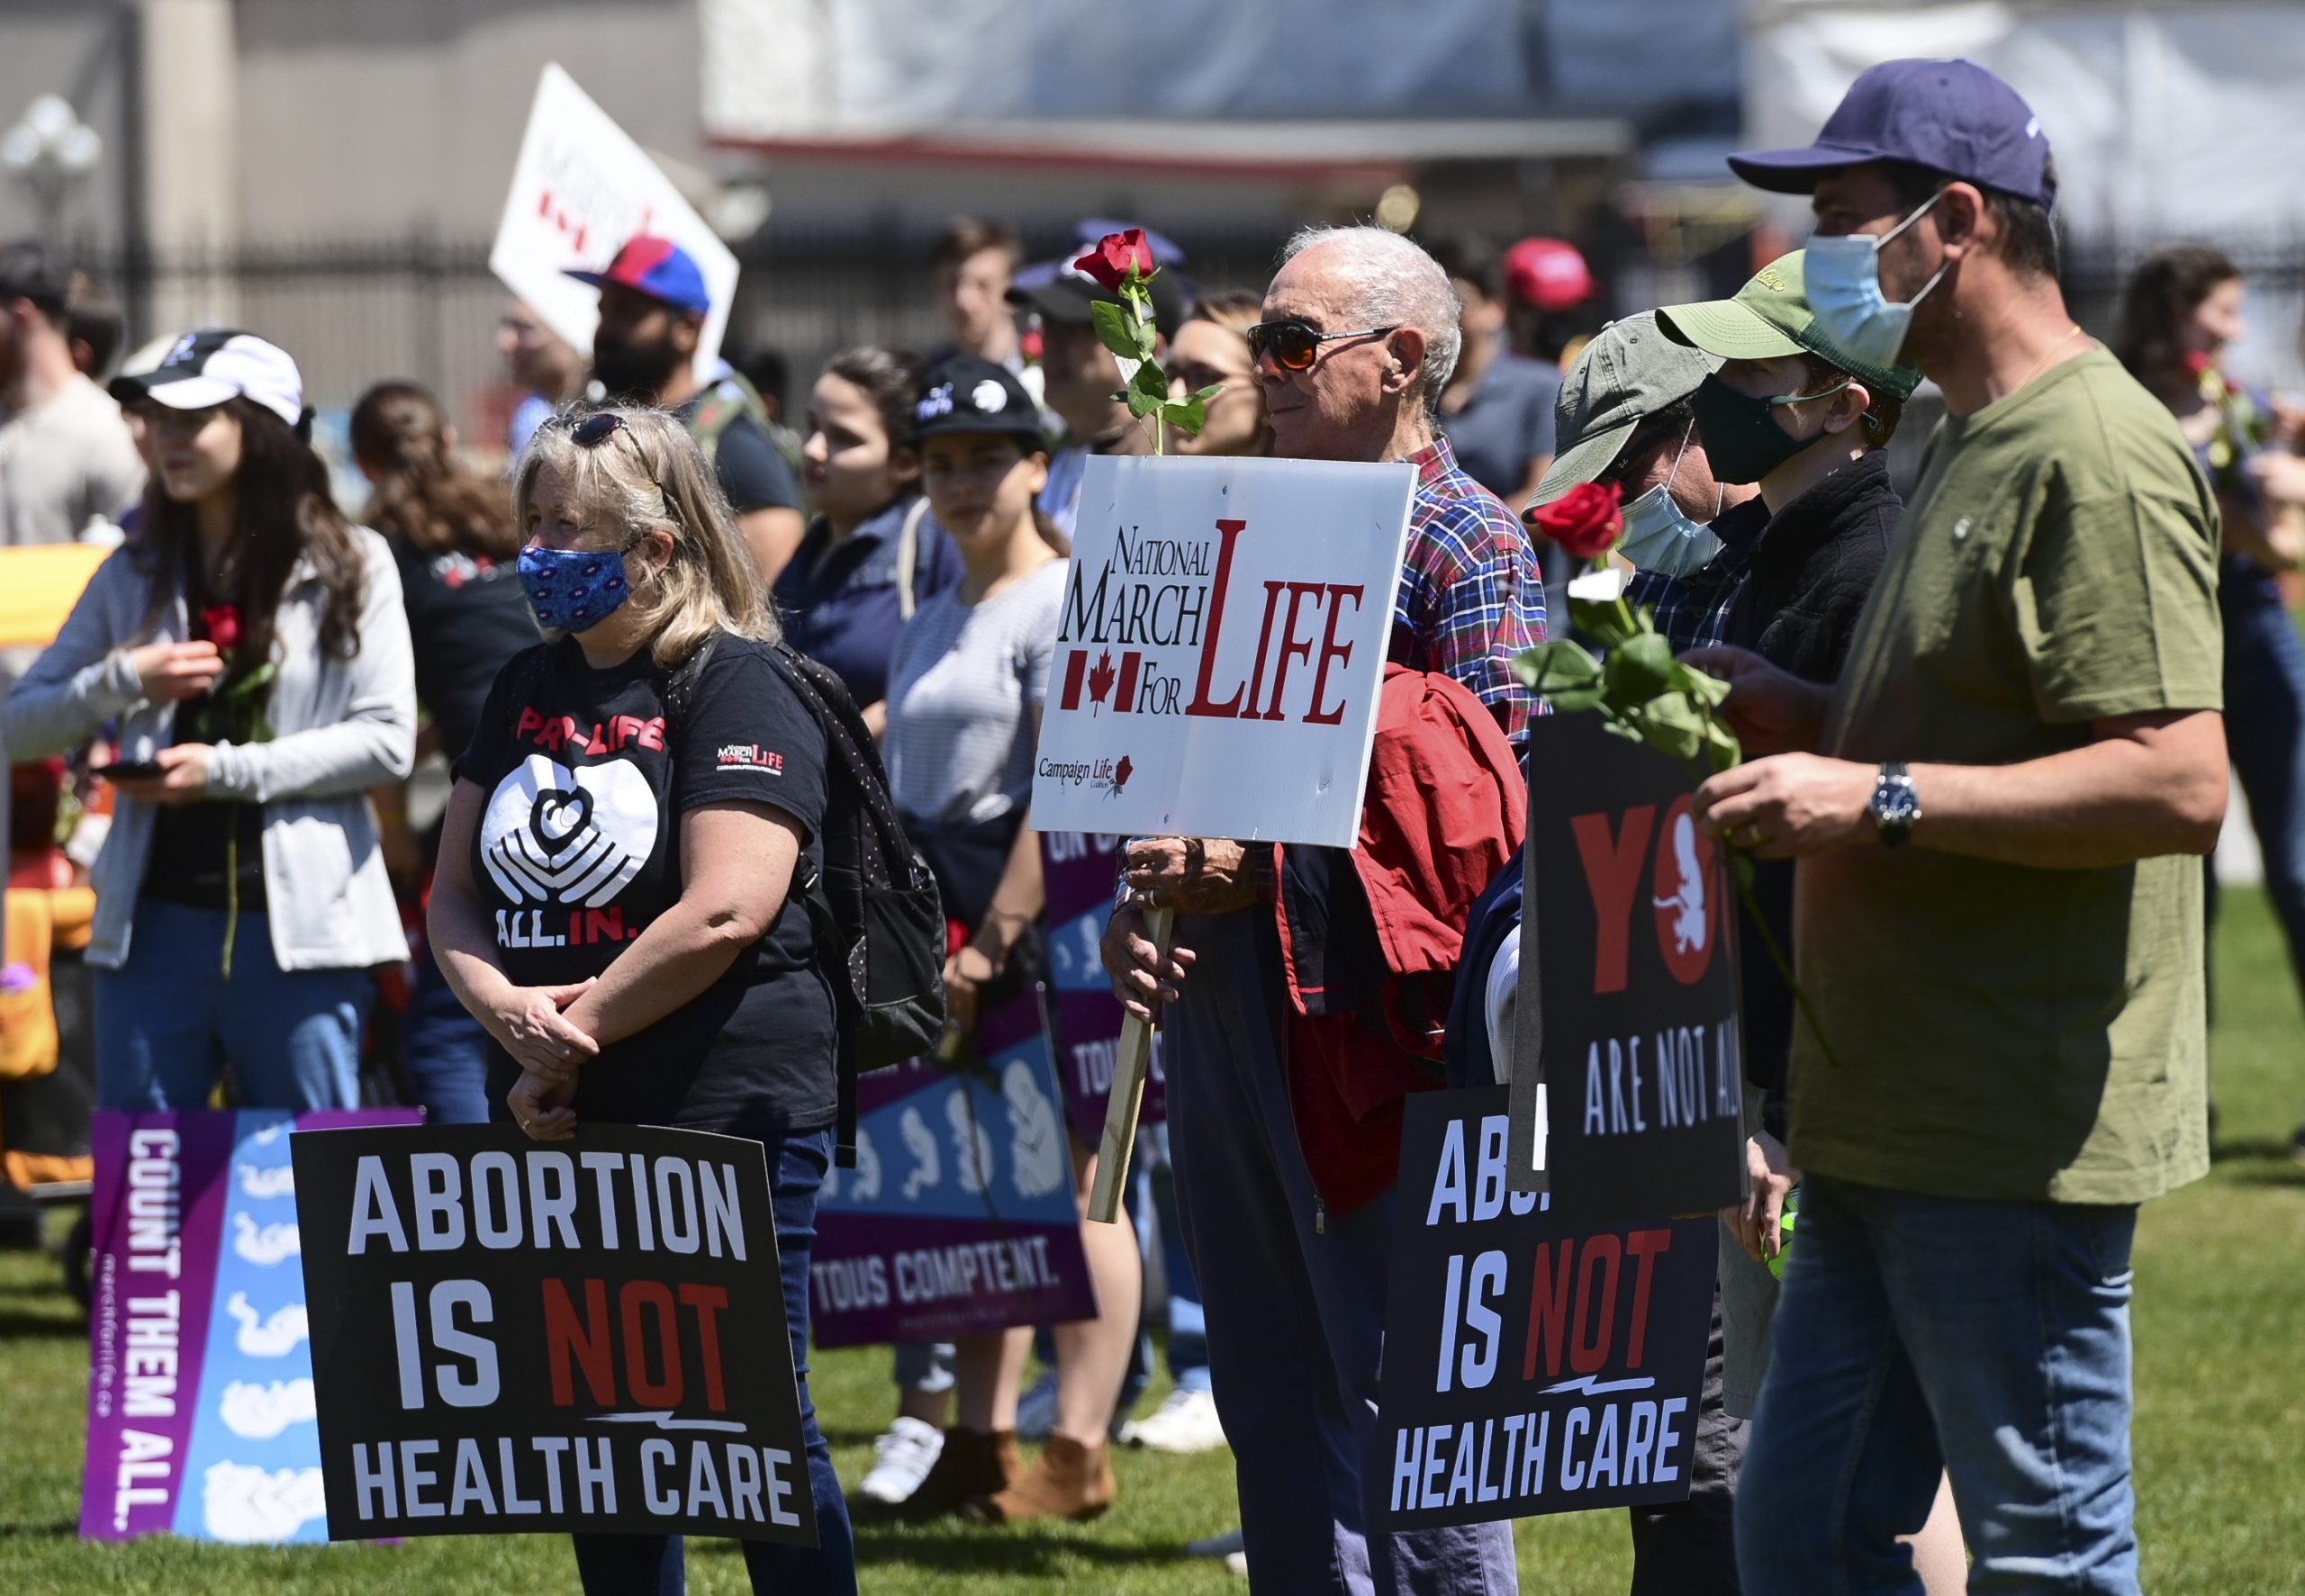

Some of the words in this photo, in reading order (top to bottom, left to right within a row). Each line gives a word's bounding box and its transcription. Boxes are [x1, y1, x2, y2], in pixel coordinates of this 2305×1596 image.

[1058, 558, 1207, 646] MARCH
[1109, 526, 1210, 577] NATIONAL
[1184, 518, 1365, 726] LIFE
[1136, 662, 1182, 715] FOR
[752, 744, 782, 770] LIFE
[1038, 758, 1089, 786] Campaign
[1093, 758, 1113, 780] Life
[1570, 792, 1724, 994] YO
[1072, 1036, 1121, 1096] TOU
[1584, 1033, 1647, 1137] ARE
[1656, 1024, 1708, 1129] NOT
[128, 1129, 182, 1280] COUNT
[347, 1150, 747, 1261] ABORTION
[811, 1254, 890, 1313] TOUS
[892, 1234, 1061, 1303] COMPTENT.
[1436, 1249, 1507, 1393] IS
[1523, 1228, 1672, 1381] NOT
[122, 1289, 180, 1417] THEM
[390, 1278, 501, 1410] IS
[541, 1278, 729, 1412] NOT
[113, 1428, 174, 1532] ALL.
[352, 1437, 619, 1519] HEALTH
[639, 1438, 800, 1527] CARE
[1390, 1411, 1550, 1512] HEALTH
[1559, 1396, 1688, 1492] CARE
